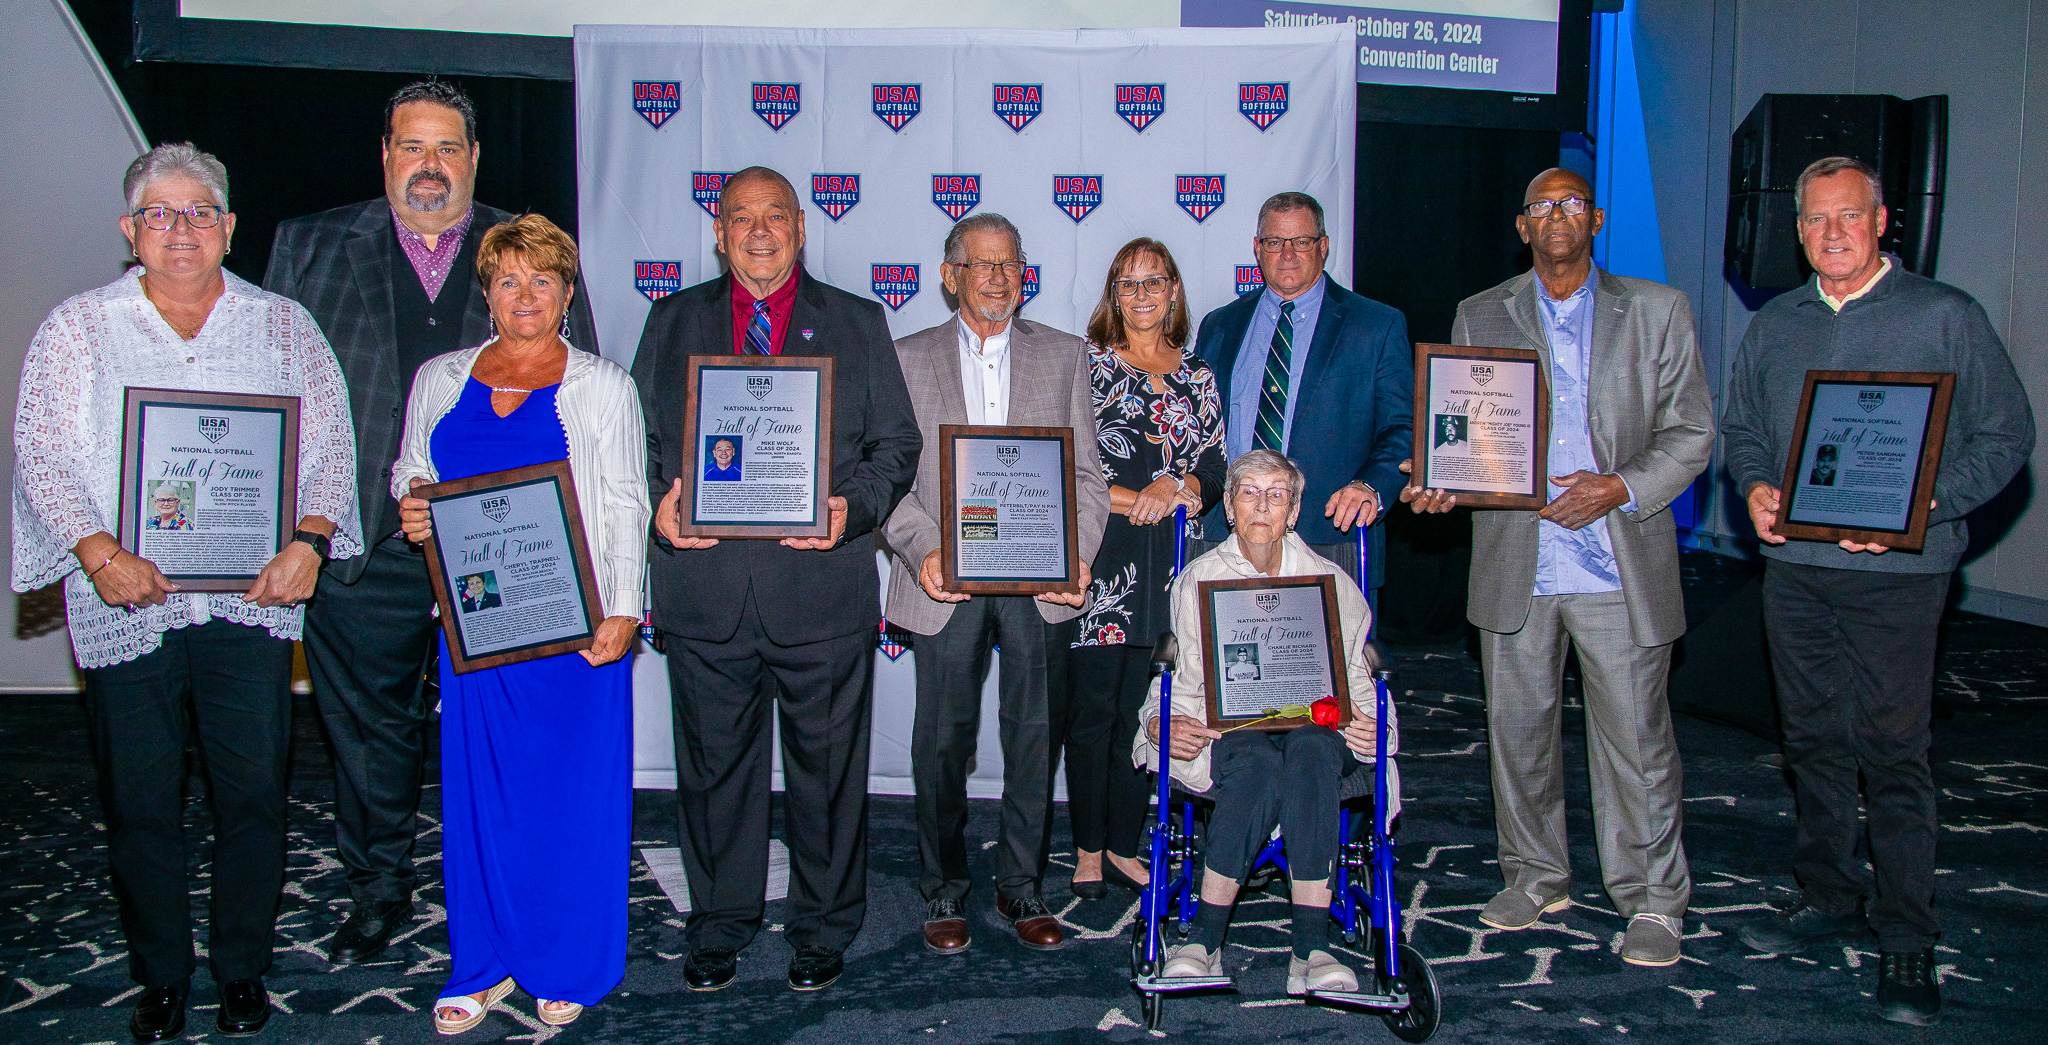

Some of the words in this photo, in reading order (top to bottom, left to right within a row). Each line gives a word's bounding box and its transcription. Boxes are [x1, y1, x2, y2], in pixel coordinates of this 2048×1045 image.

[1414, 21, 1438, 44] 26,
[1442, 22, 1482, 44] 2024
[1360, 47, 1445, 71] Convention
[1449, 52, 1499, 74] Center
[634, 83, 678, 100] USA
[754, 85, 798, 102] USA
[873, 86, 918, 103] USA
[995, 86, 1040, 103] USA
[1117, 86, 1162, 103] USA
[1241, 85, 1286, 101] USA
[636, 100, 678, 108] SOFTBALL
[755, 102, 797, 111] SOFTBALL
[875, 103, 918, 112] SOFTBALL
[996, 103, 1040, 112] SOFTBALL
[1119, 103, 1162, 112] SOFTBALL
[1242, 102, 1286, 110] SOFTBALL
[694, 174, 733, 190] US
[814, 176, 858, 192] USA
[934, 176, 978, 193] USA
[1055, 177, 1100, 194] USA
[1178, 177, 1222, 193] USA
[815, 192, 857, 201] SOFTBALL
[1057, 194, 1099, 202] SOFTBALL
[1179, 194, 1222, 202] SOFTBALL
[636, 263, 679, 278] USA
[873, 266, 918, 283] USA
[1238, 268, 1265, 283] US
[875, 283, 917, 291] SOFTBALL
[1442, 399, 1469, 414] Hall
[1471, 400, 1484, 419] of
[1486, 402, 1521, 417] Fame
[201, 418, 227, 427] USA
[715, 416, 746, 434] Hall
[747, 416, 761, 440] of
[764, 419, 802, 436] Fame
[1820, 427, 1852, 443] Hall
[1851, 428, 1868, 450] of
[1869, 430, 1907, 447] Fame
[160, 459, 197, 477] Hall
[199, 459, 216, 486] of
[219, 462, 264, 481] Fame
[970, 481, 997, 498] Hall
[999, 481, 1011, 503] of
[1015, 483, 1049, 499] Fame
[483, 498, 508, 508] USA
[464, 530, 501, 541] NATIONAL
[502, 522, 540, 534] SOFTBALL
[460, 542, 491, 566] Hall
[495, 538, 508, 566] of
[512, 537, 554, 561] Fame
[529, 556, 560, 564] TRAPNELL
[1231, 627, 1259, 642] Hall
[1261, 626, 1273, 646] of
[1277, 626, 1313, 642] Fame
